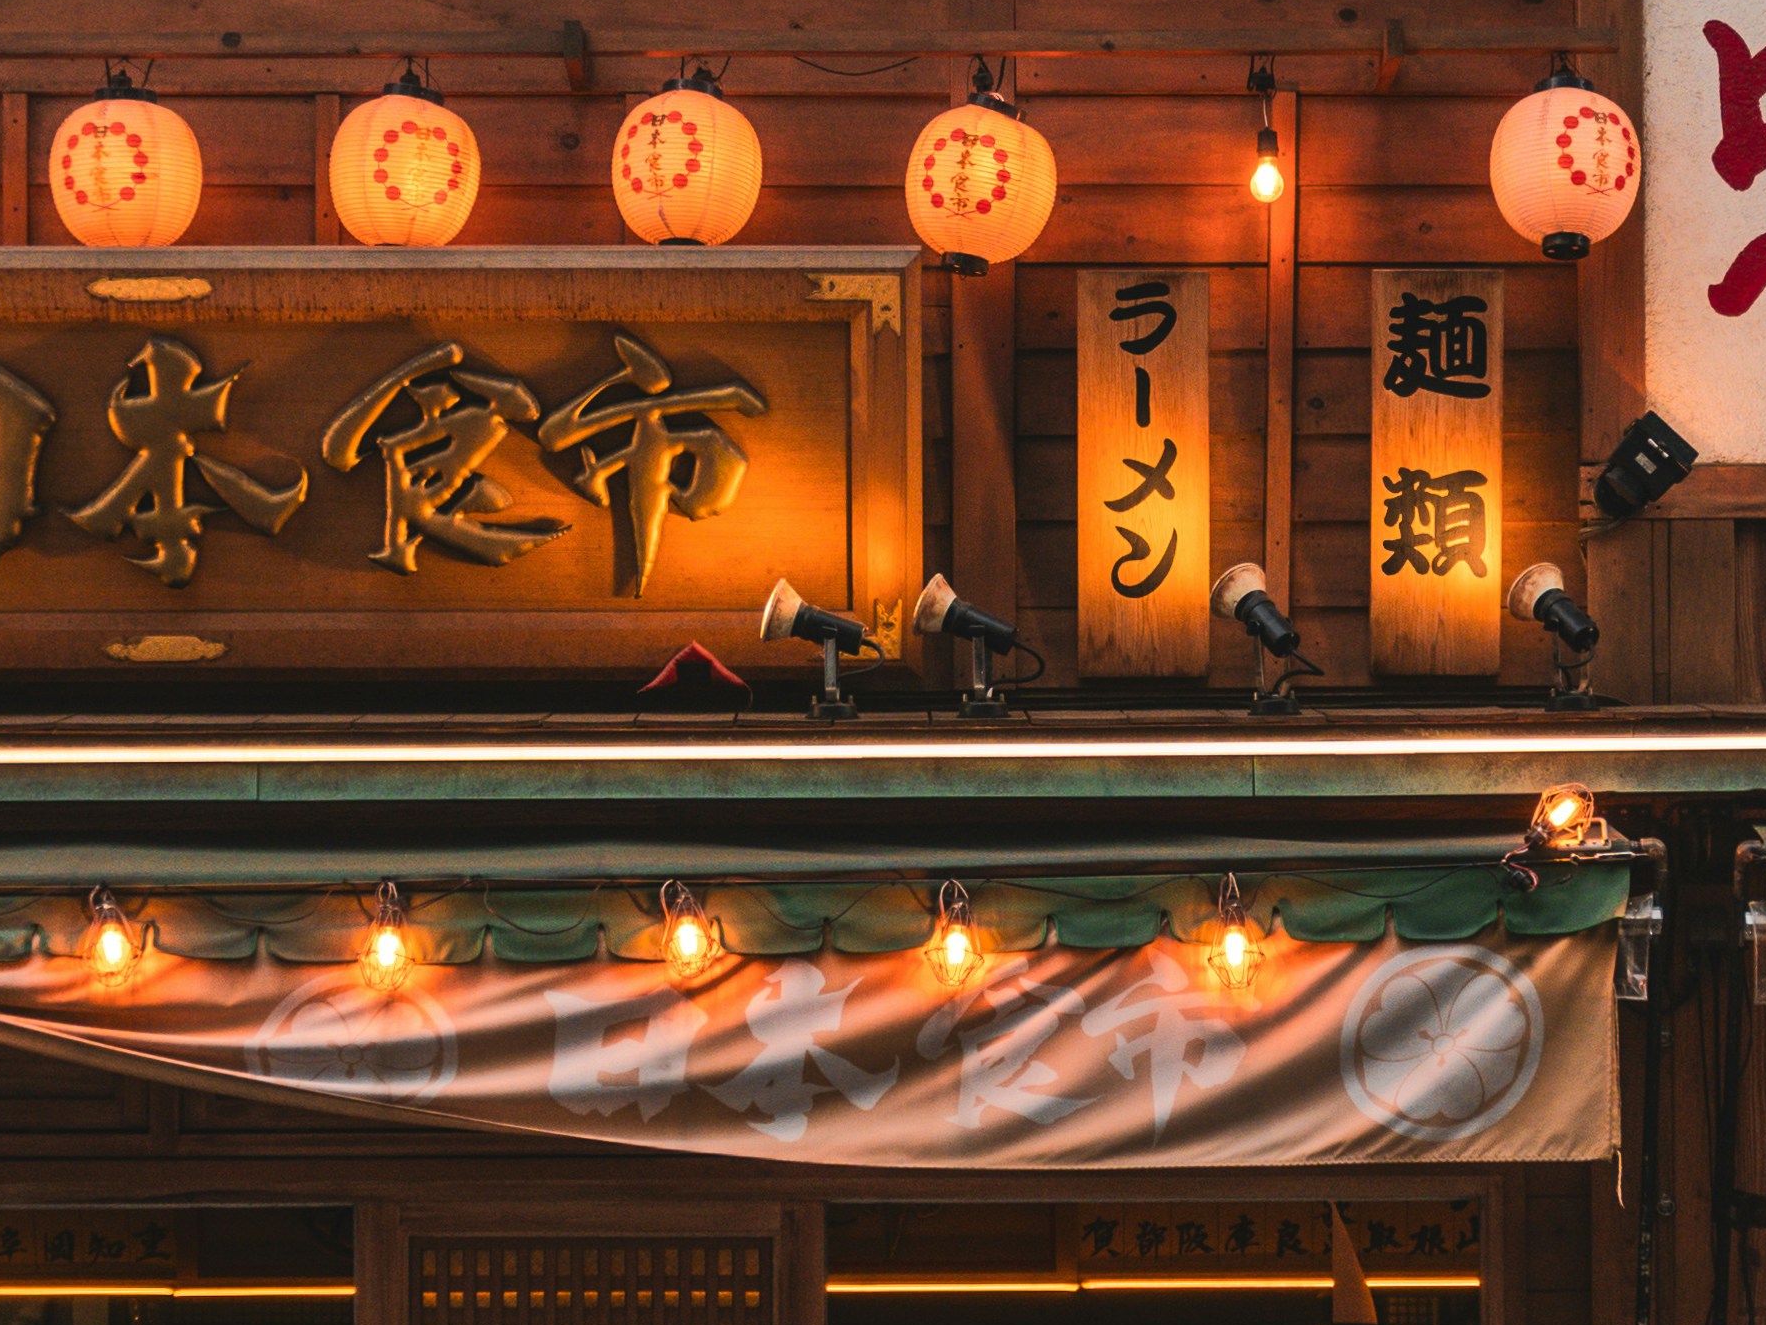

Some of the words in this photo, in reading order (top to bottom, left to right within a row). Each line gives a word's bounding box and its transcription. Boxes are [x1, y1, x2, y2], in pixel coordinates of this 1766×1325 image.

[646, 114, 666, 188] 日本食市
[950, 132, 979, 210] 日本食市
[1592, 110, 1613, 187] 日本食市
[1103, 281, 1178, 599] ラーメン
[1381, 291, 1492, 578] 麺類
[544, 959, 1261, 1148] 日本食市
